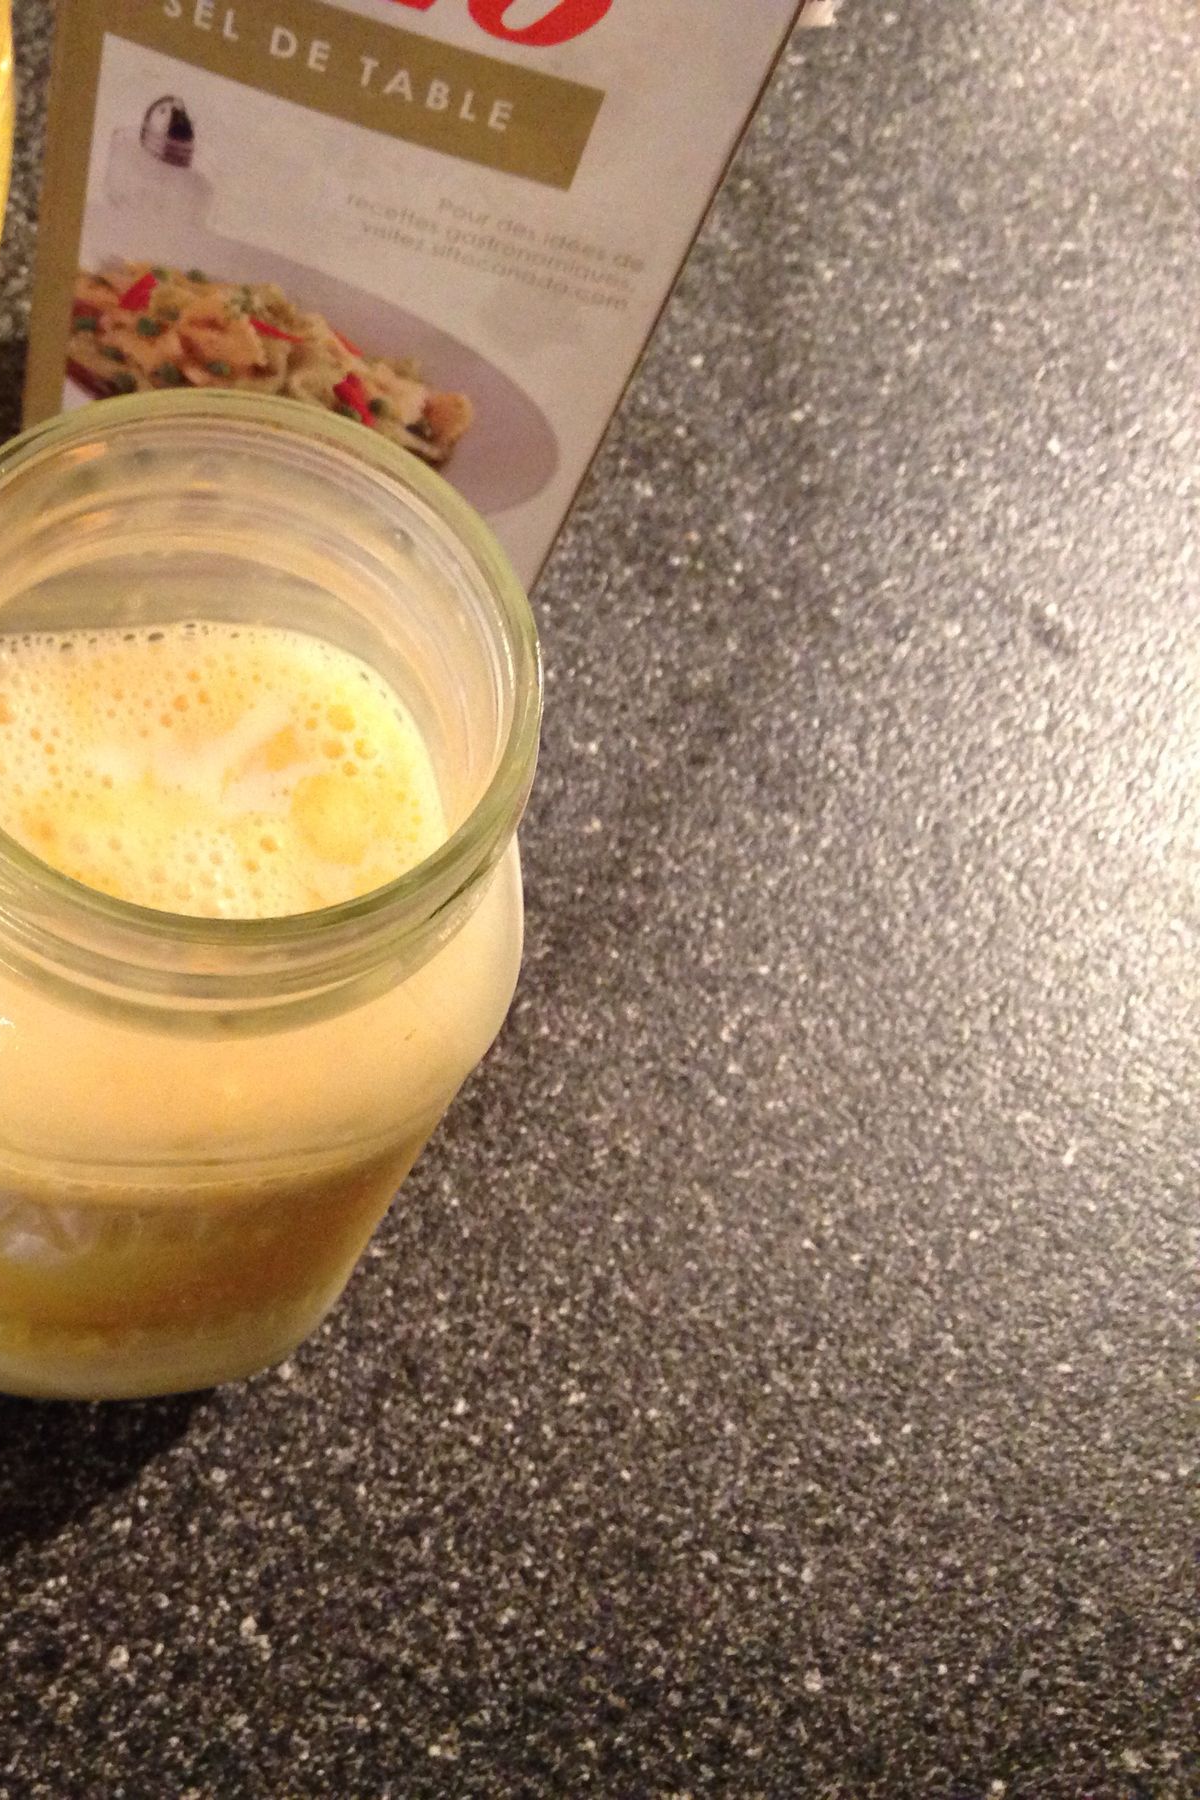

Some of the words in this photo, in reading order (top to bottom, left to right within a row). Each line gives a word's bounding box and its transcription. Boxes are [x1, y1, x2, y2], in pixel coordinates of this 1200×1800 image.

[163, 0, 240, 42] SEL
[268, 26, 332, 73] DE
[359, 55, 515, 133] TABLE
[438, 197, 491, 227] Pour
[613, 250, 646, 273] de
